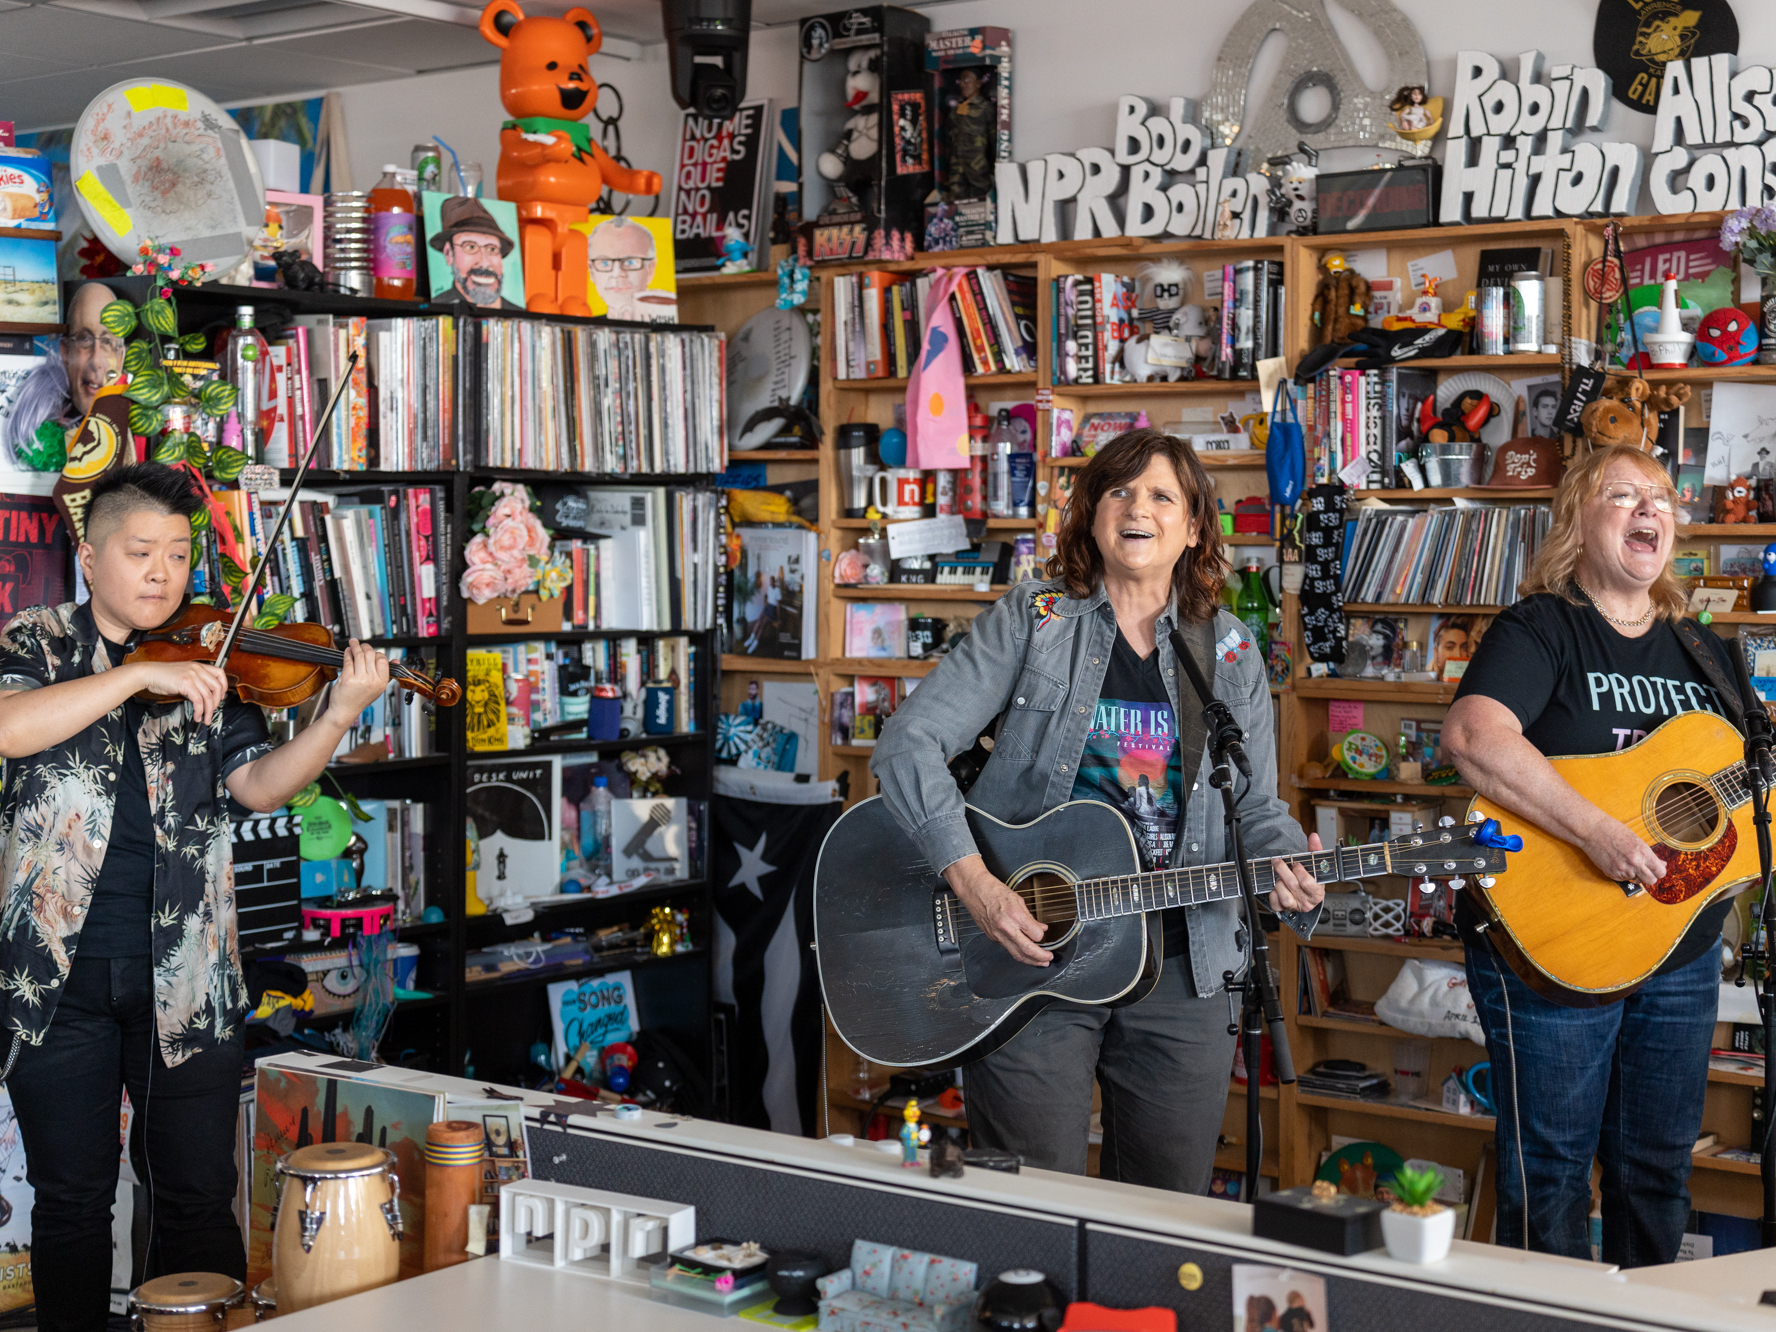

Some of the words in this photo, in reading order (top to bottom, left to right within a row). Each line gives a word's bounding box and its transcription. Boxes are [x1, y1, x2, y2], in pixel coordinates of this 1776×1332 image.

[1447, 50, 1608, 137] Robin
[1652, 53, 1776, 153] Alls
[722, 109, 755, 137] ME
[1115, 94, 1212, 172] Bob
[683, 134, 747, 165] DIGAS
[680, 162, 727, 190] QUE
[1439, 130, 1642, 224] Hilton
[677, 189, 710, 215] NO
[995, 147, 1122, 243] NPR
[1125, 150, 1272, 239] Boilen
[674, 209, 750, 240] BAILAS
[813, 223, 868, 260] KISS
[1504, 263, 1527, 272] OWN
[1481, 278, 1509, 287] DEVI
[1110, 292, 1139, 310] ASK
[1110, 321, 1140, 342] BOB
[1077, 331, 1094, 384] REED
[1366, 370, 1382, 412] THIS
[1088, 421, 1130, 433] NOW
[1366, 448, 1382, 489] CALL
[1505, 450, 1538, 467] Don't
[1506, 464, 1536, 479] Trip
[1586, 672, 1727, 719] PROTECT
[1150, 709, 1170, 736] IS
[1117, 740, 1171, 751] FESTIVAL
[474, 771, 506, 783] DESK
[512, 769, 543, 780] UNIT
[265, 861, 281, 870] DATE
[625, 868, 640, 878] on
[577, 986, 623, 1012] SONG
[565, 1005, 629, 1044] Changed
[1443, 1009, 1469, 1022] APRIL
[513, 1194, 663, 1261] npr
